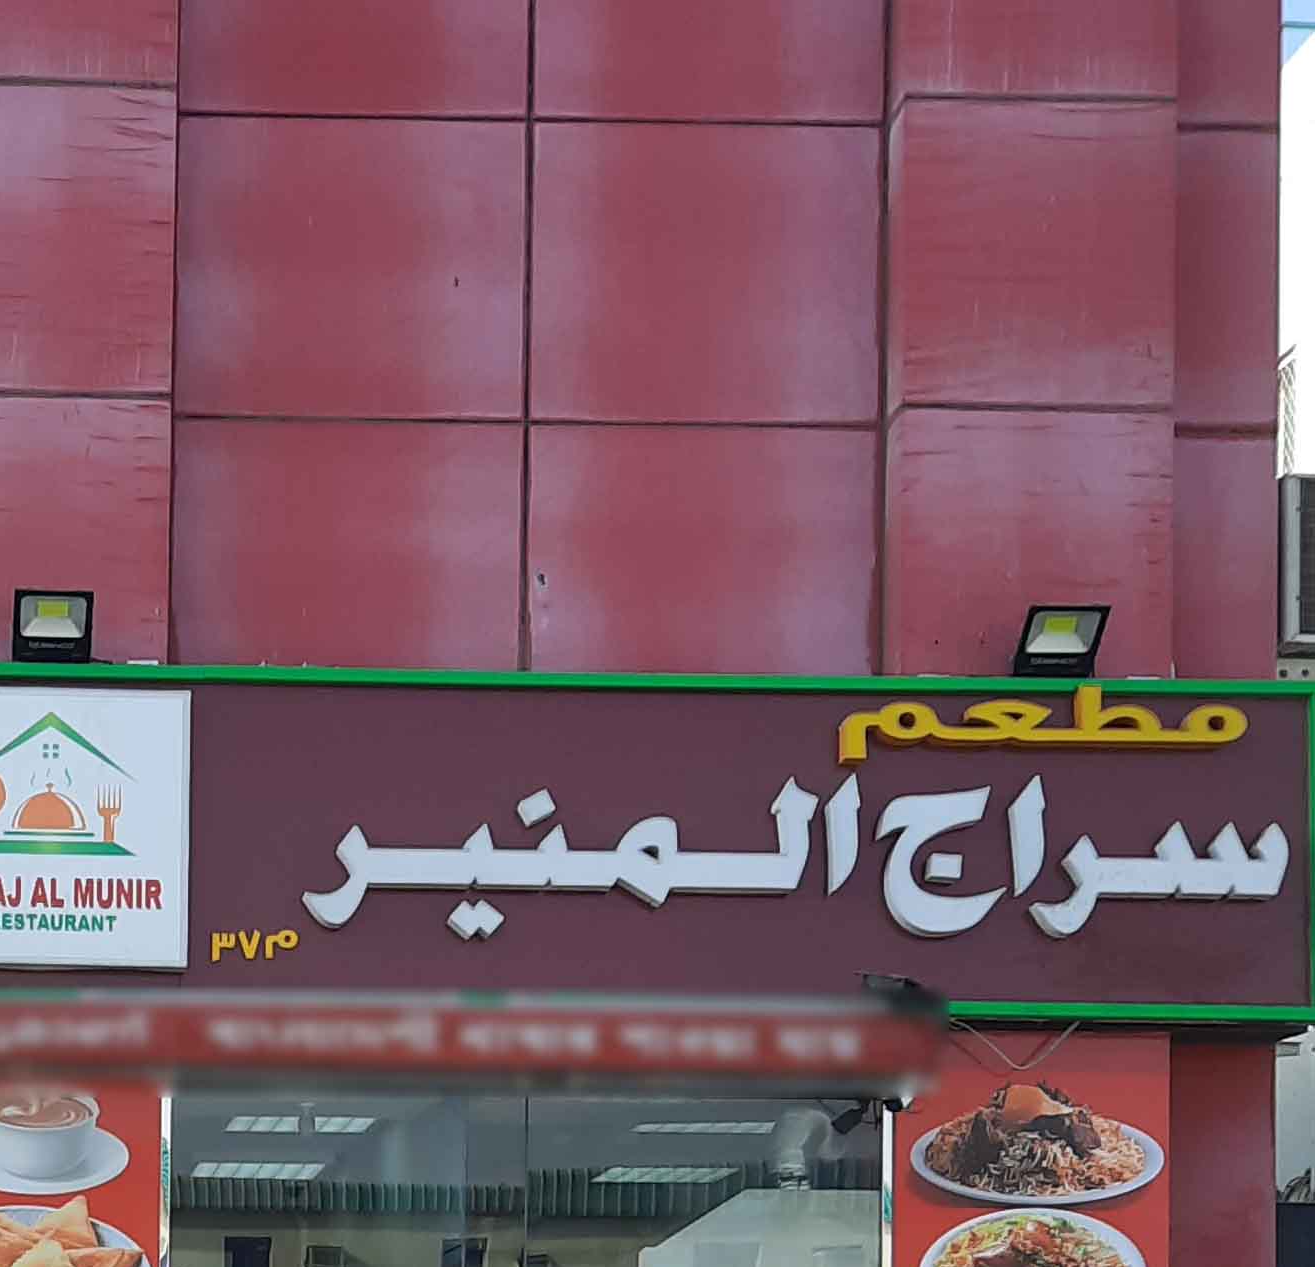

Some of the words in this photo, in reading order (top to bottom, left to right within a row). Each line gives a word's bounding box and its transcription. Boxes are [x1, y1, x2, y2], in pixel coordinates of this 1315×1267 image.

[838, 684, 1249, 764] مطعم
[30, 877, 65, 909] AL
[74, 878, 163, 910] MUNIR
[301, 773, 862, 942] المنير
[875, 774, 1291, 938] سراج
